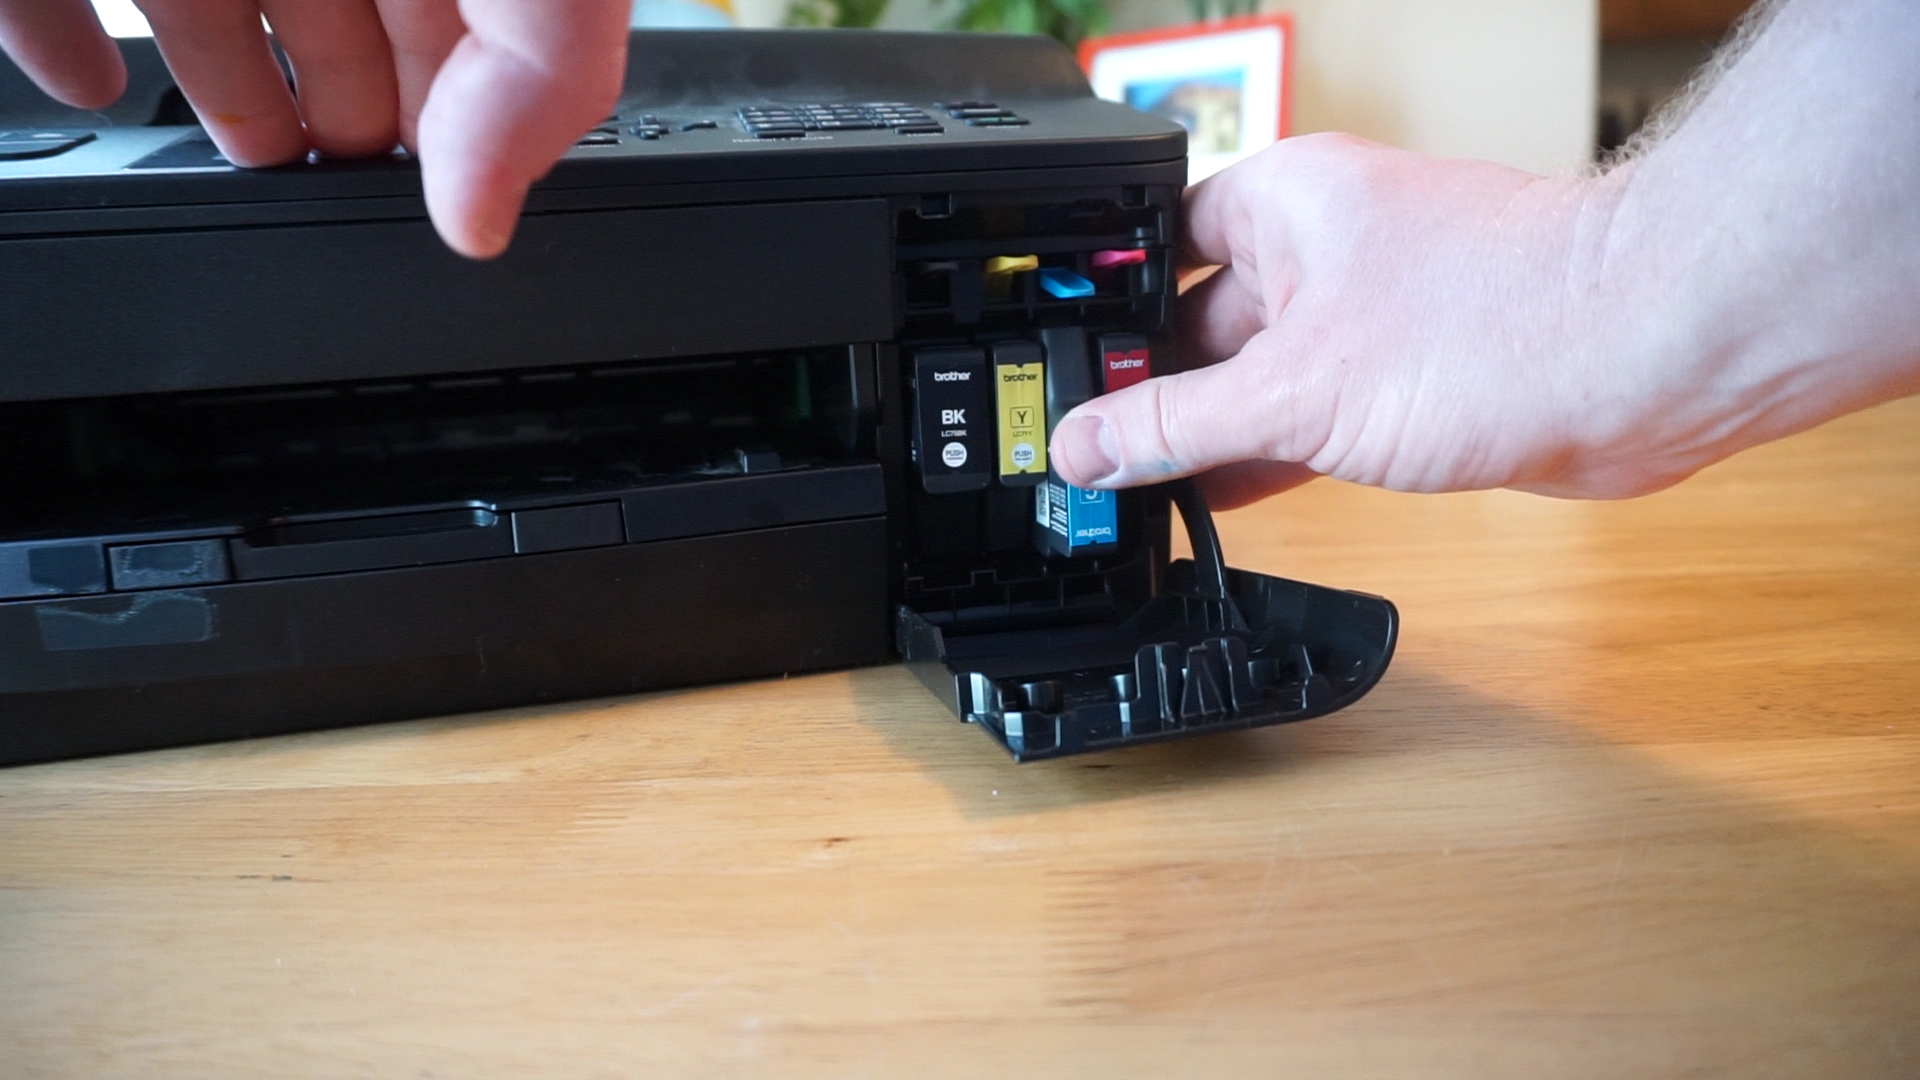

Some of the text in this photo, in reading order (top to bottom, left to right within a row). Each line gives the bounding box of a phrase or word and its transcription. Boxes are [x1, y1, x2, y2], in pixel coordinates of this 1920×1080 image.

[1110, 359, 1144, 370] brother
[934, 371, 971, 381] brother
[1003, 373, 1038, 382] brother
[941, 409, 966, 425] BK
[1016, 410, 1028, 425] Y
[945, 449, 964, 457] PUSH
[1075, 526, 1112, 538] brother
